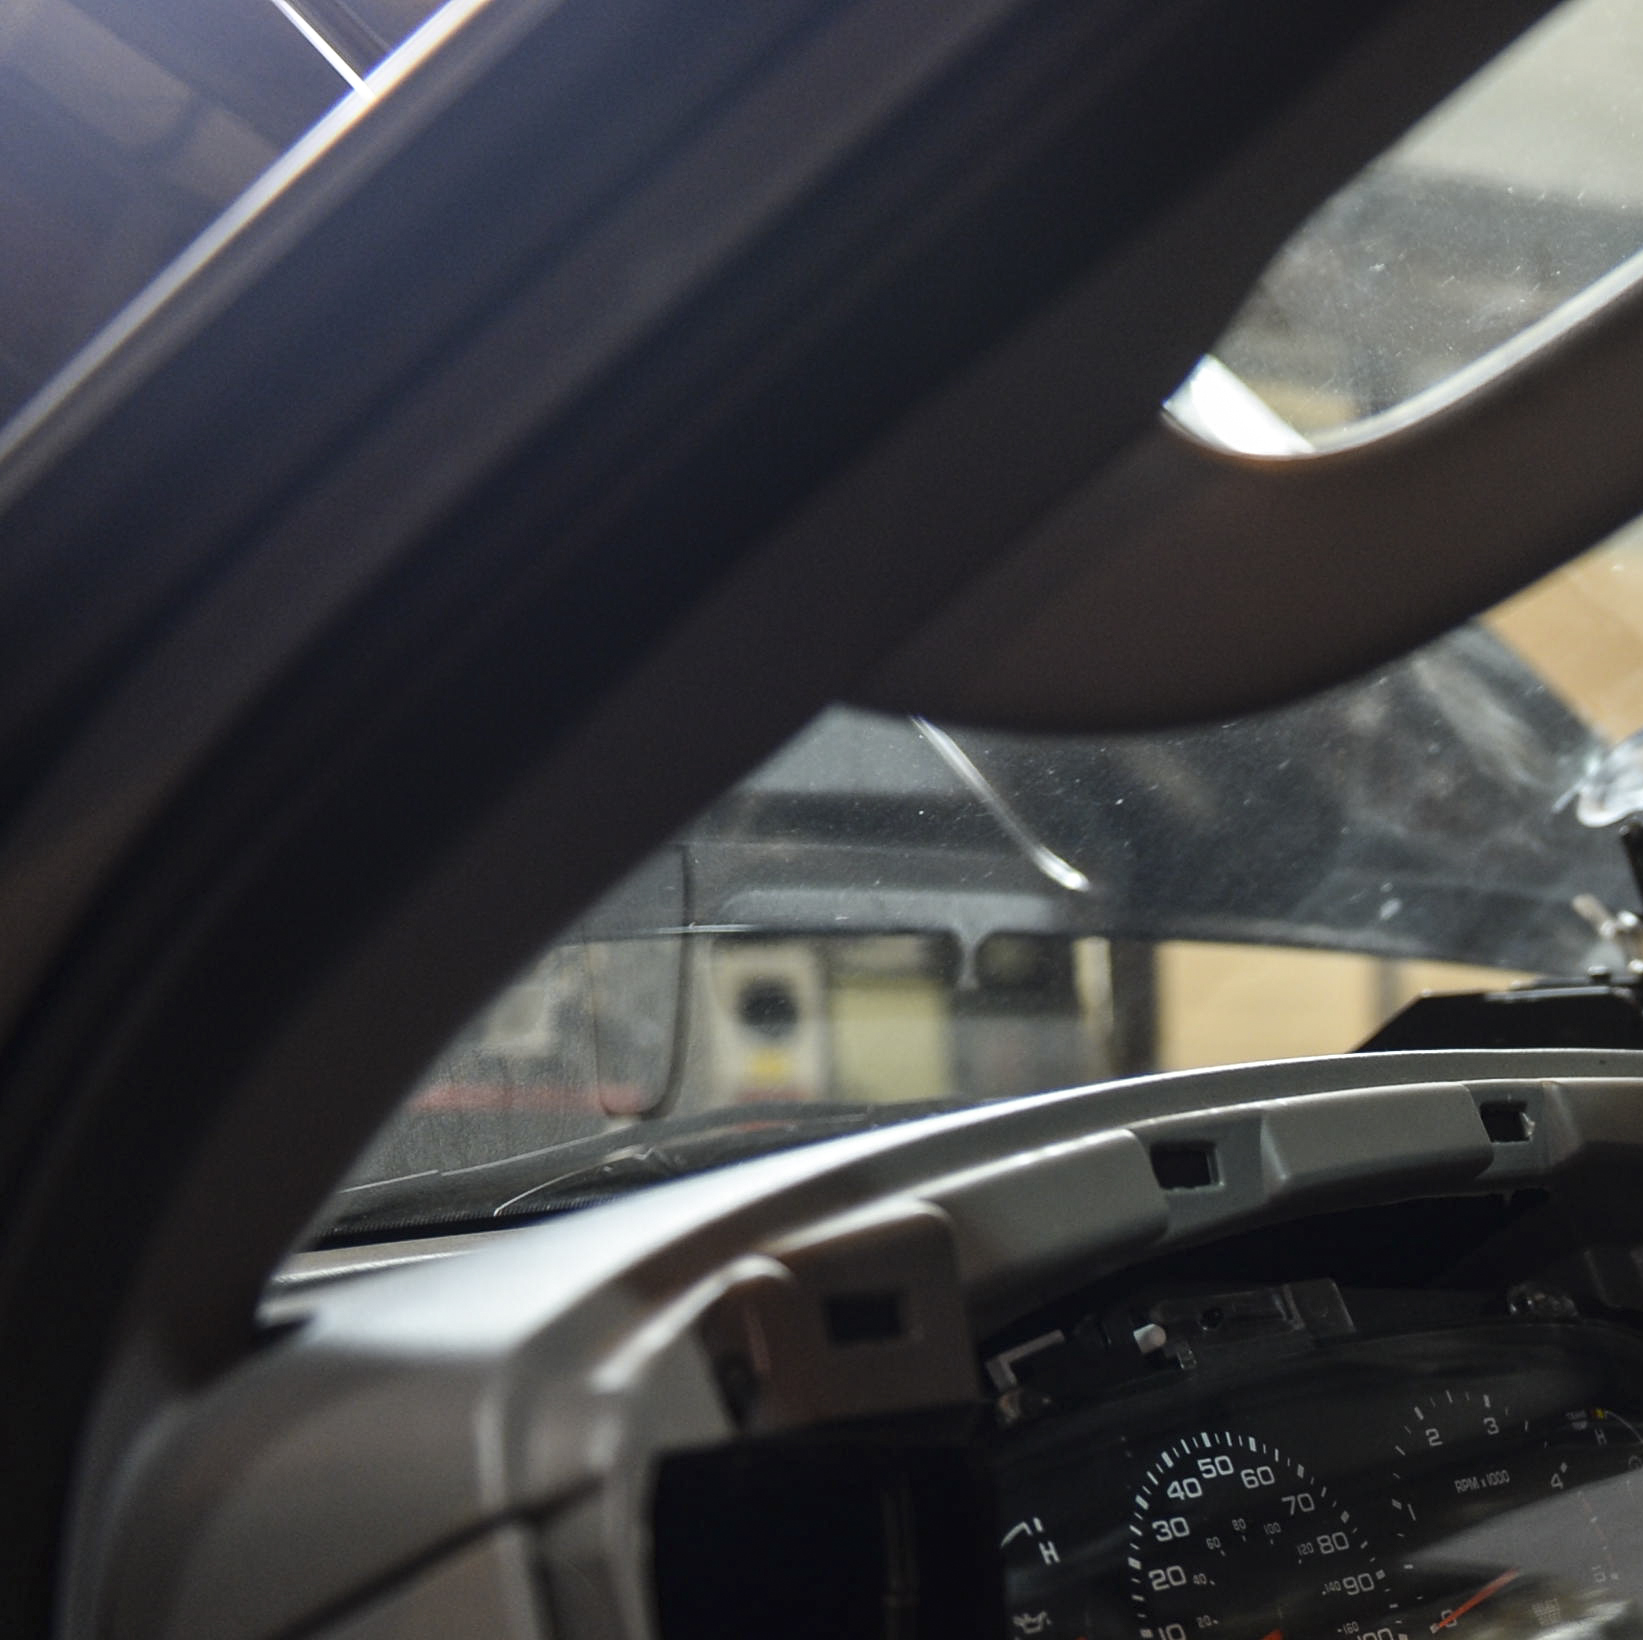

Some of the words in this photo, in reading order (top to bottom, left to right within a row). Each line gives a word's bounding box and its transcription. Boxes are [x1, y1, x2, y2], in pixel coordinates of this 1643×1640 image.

[1425, 1428, 1443, 1447] 2
[1483, 1417, 1500, 1435] 3
[1197, 1455, 1235, 1479] 50
[1240, 1465, 1276, 1490] 60
[1166, 1476, 1204, 1501] 40
[1454, 1474, 1481, 1494] RPM
[1486, 1469, 1511, 1487] 1000
[1550, 1473, 1564, 1490] 4
[1281, 1492, 1316, 1517] 70
[1151, 1516, 1191, 1543] 30
[1231, 1517, 1247, 1532] 80
[1263, 1521, 1282, 1536] 100
[1038, 1540, 1061, 1565] H
[1205, 1536, 1222, 1550] 60
[1296, 1541, 1315, 1556] 120
[1316, 1531, 1350, 1555] 80
[1147, 1565, 1187, 1591] 20
[1342, 1573, 1375, 1596] 90
[1196, 1614, 1212, 1629] 20
